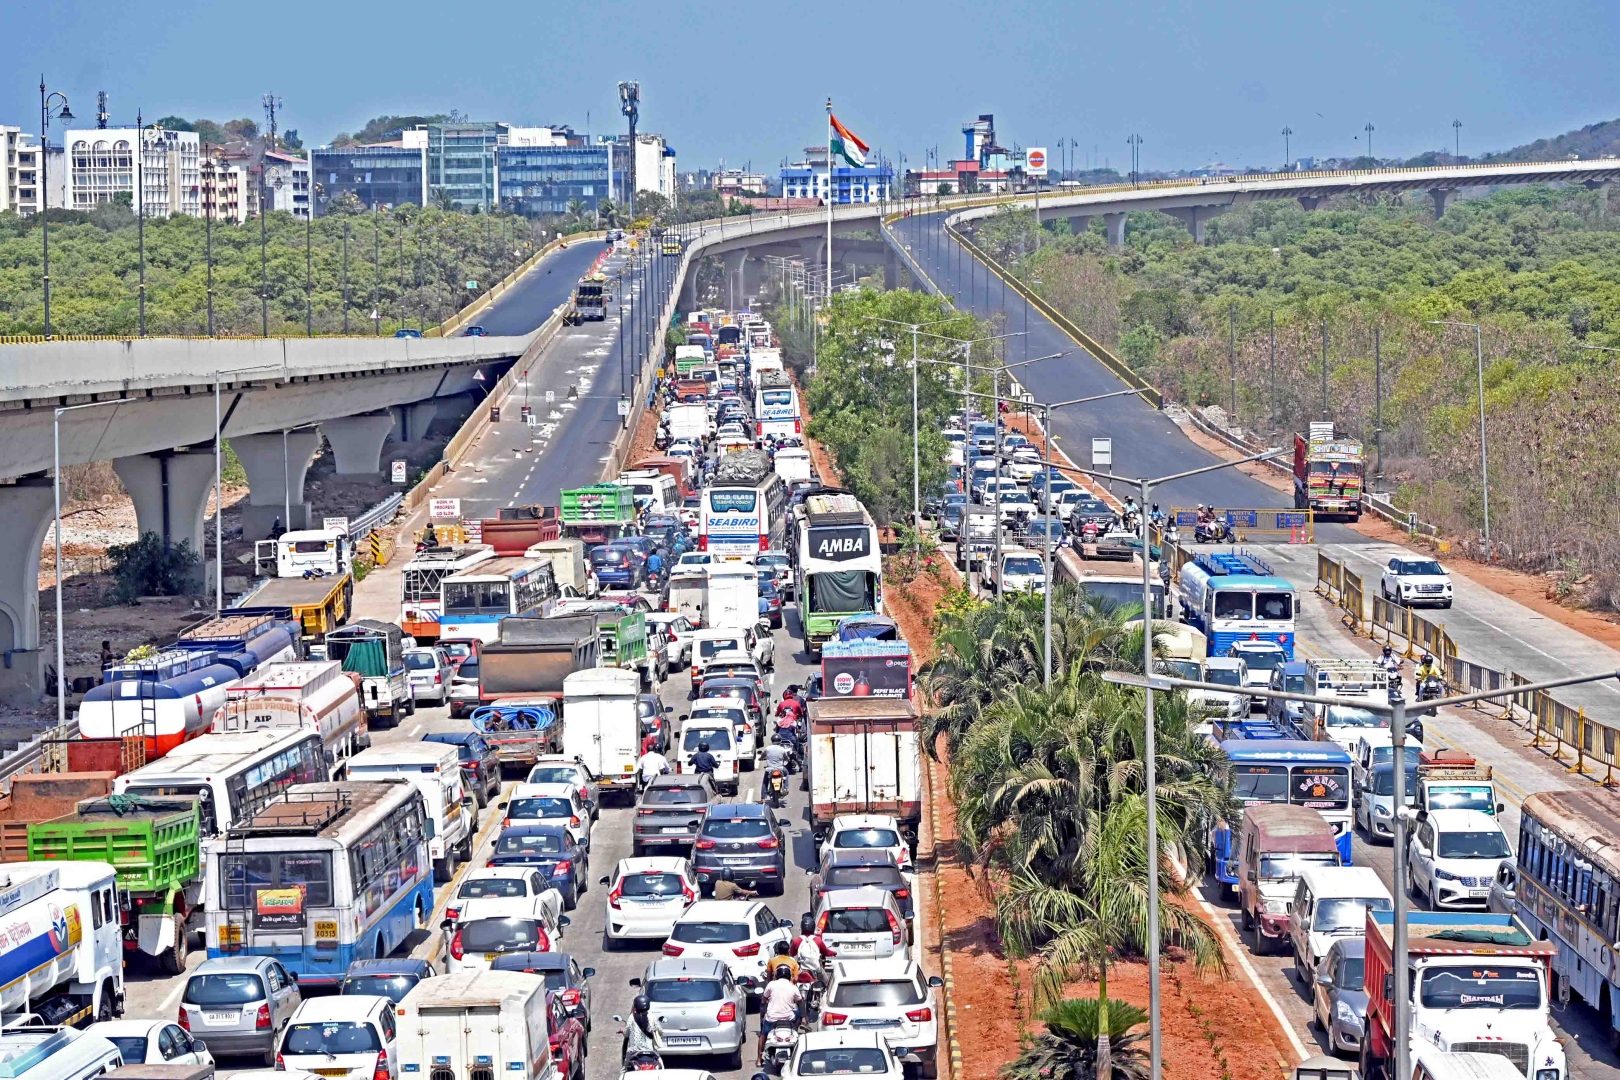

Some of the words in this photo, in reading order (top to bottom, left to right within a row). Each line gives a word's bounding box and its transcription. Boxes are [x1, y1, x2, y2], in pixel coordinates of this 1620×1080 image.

[708, 518, 758, 526] SEABIRD
[818, 538, 863, 553] AMBA
[254, 715, 272, 723] AIP
